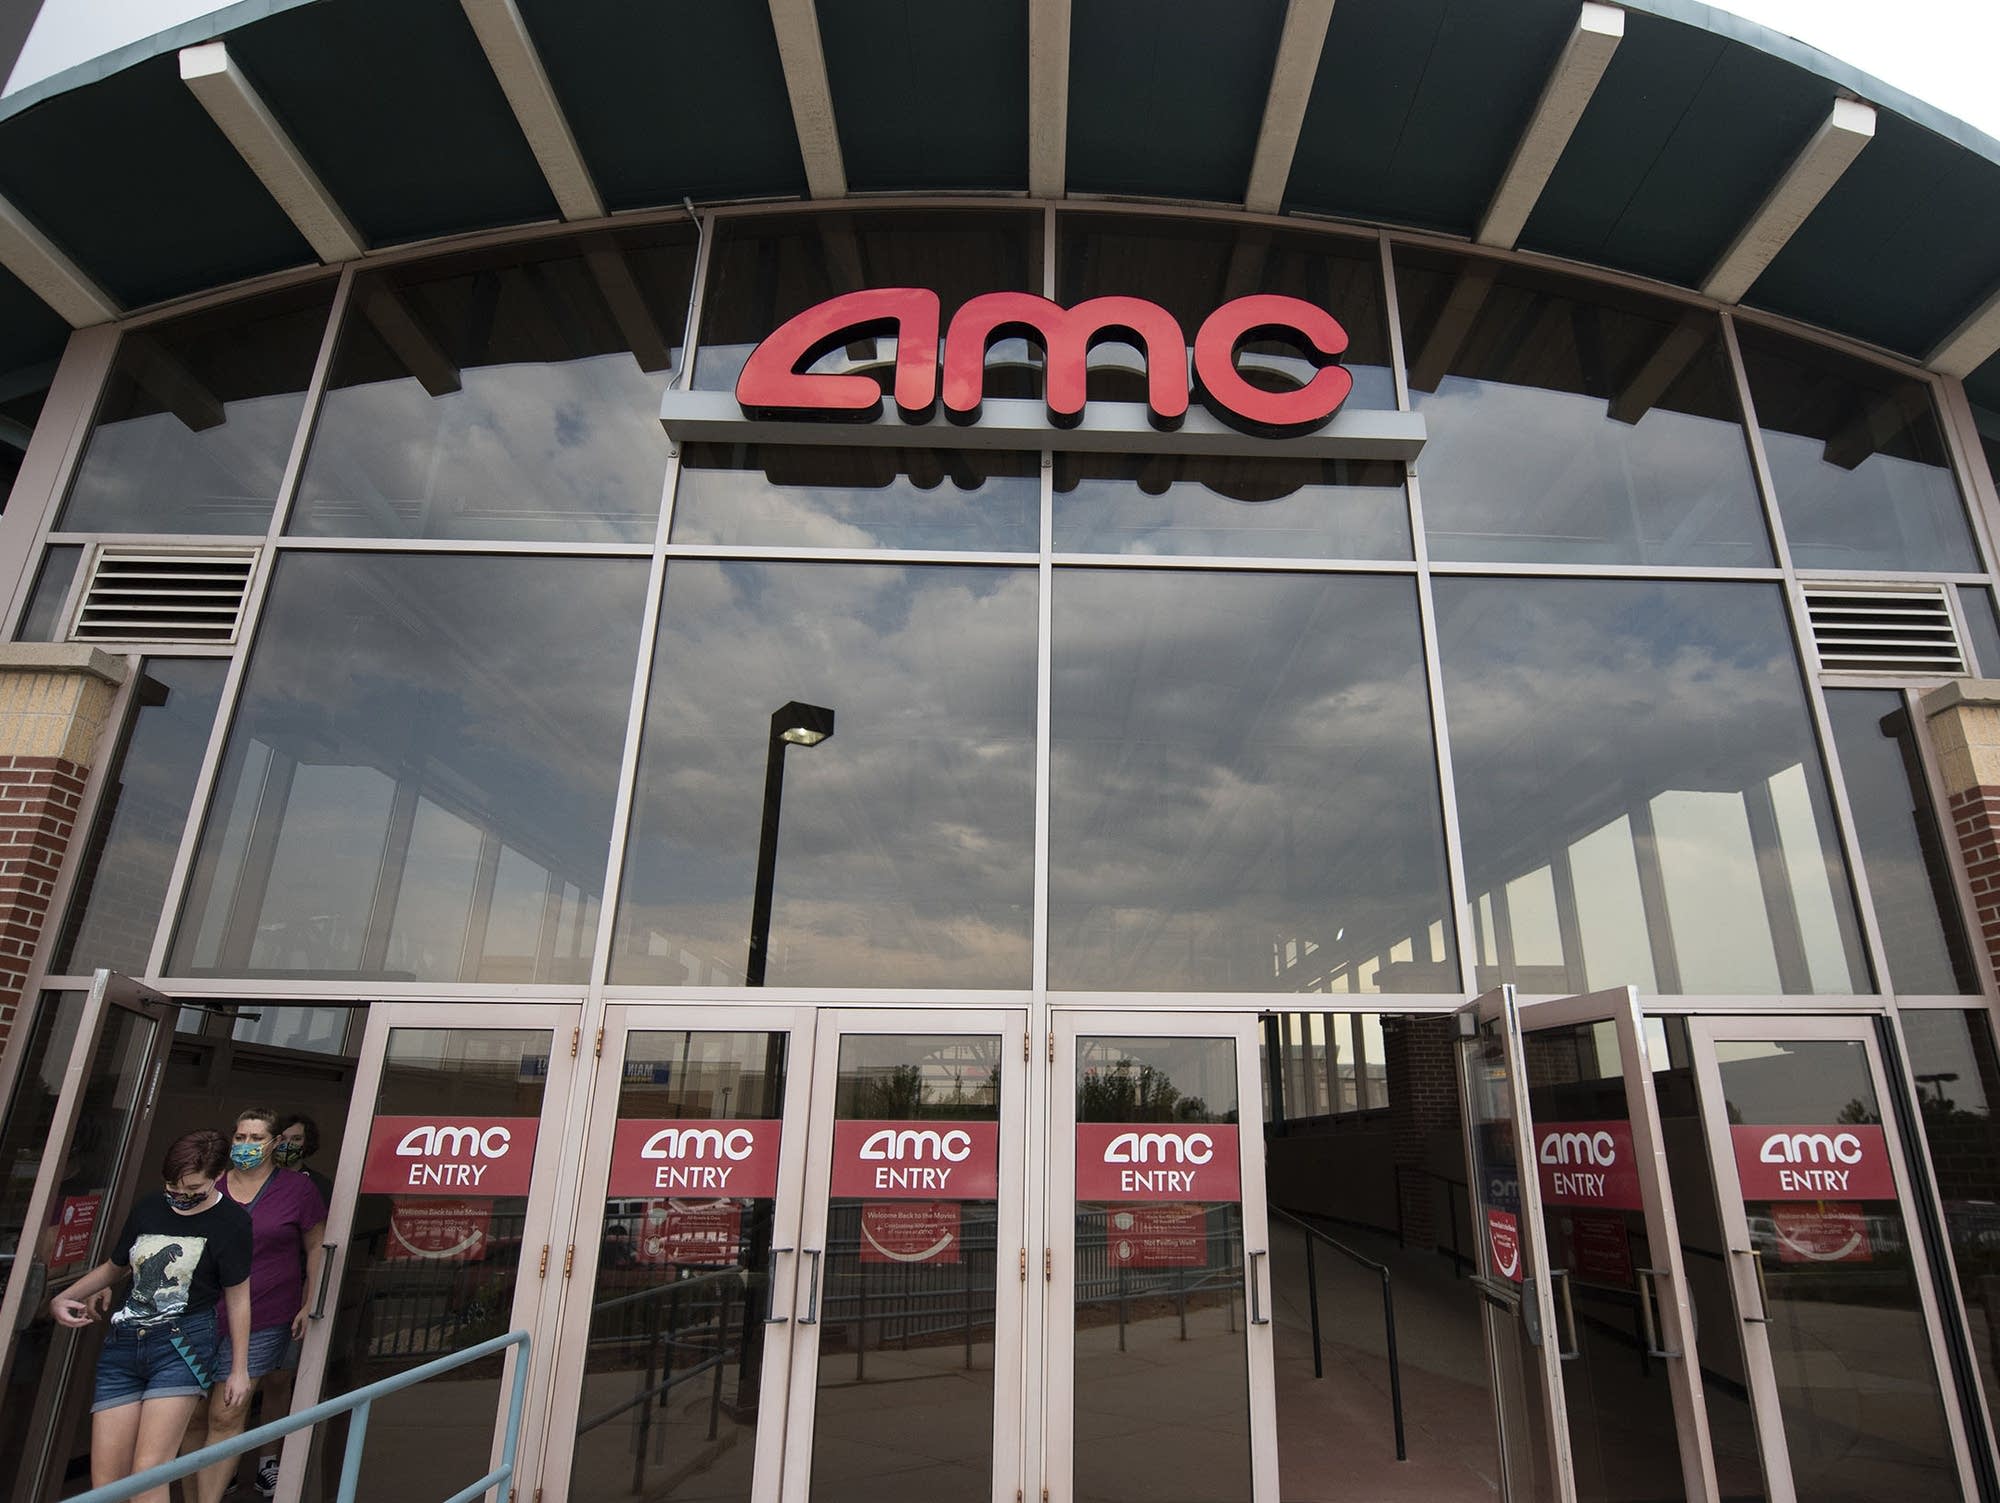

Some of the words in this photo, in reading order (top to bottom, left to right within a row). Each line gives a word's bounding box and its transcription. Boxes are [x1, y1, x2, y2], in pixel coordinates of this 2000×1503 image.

[408, 1163, 488, 1186] ENTRY
[655, 1166, 733, 1189] ENTRY
[875, 1167, 952, 1190] ENTRY
[1121, 1170, 1196, 1192] ENTRY
[1553, 1172, 1606, 1198] ENTRY
[1779, 1169, 1849, 1191] ENTRY
[867, 1211, 897, 1219] Welcome
[897, 1211, 913, 1219] Back
[914, 1211, 922, 1219] to
[922, 1211, 933, 1219] the
[933, 1211, 956, 1219] Movies
